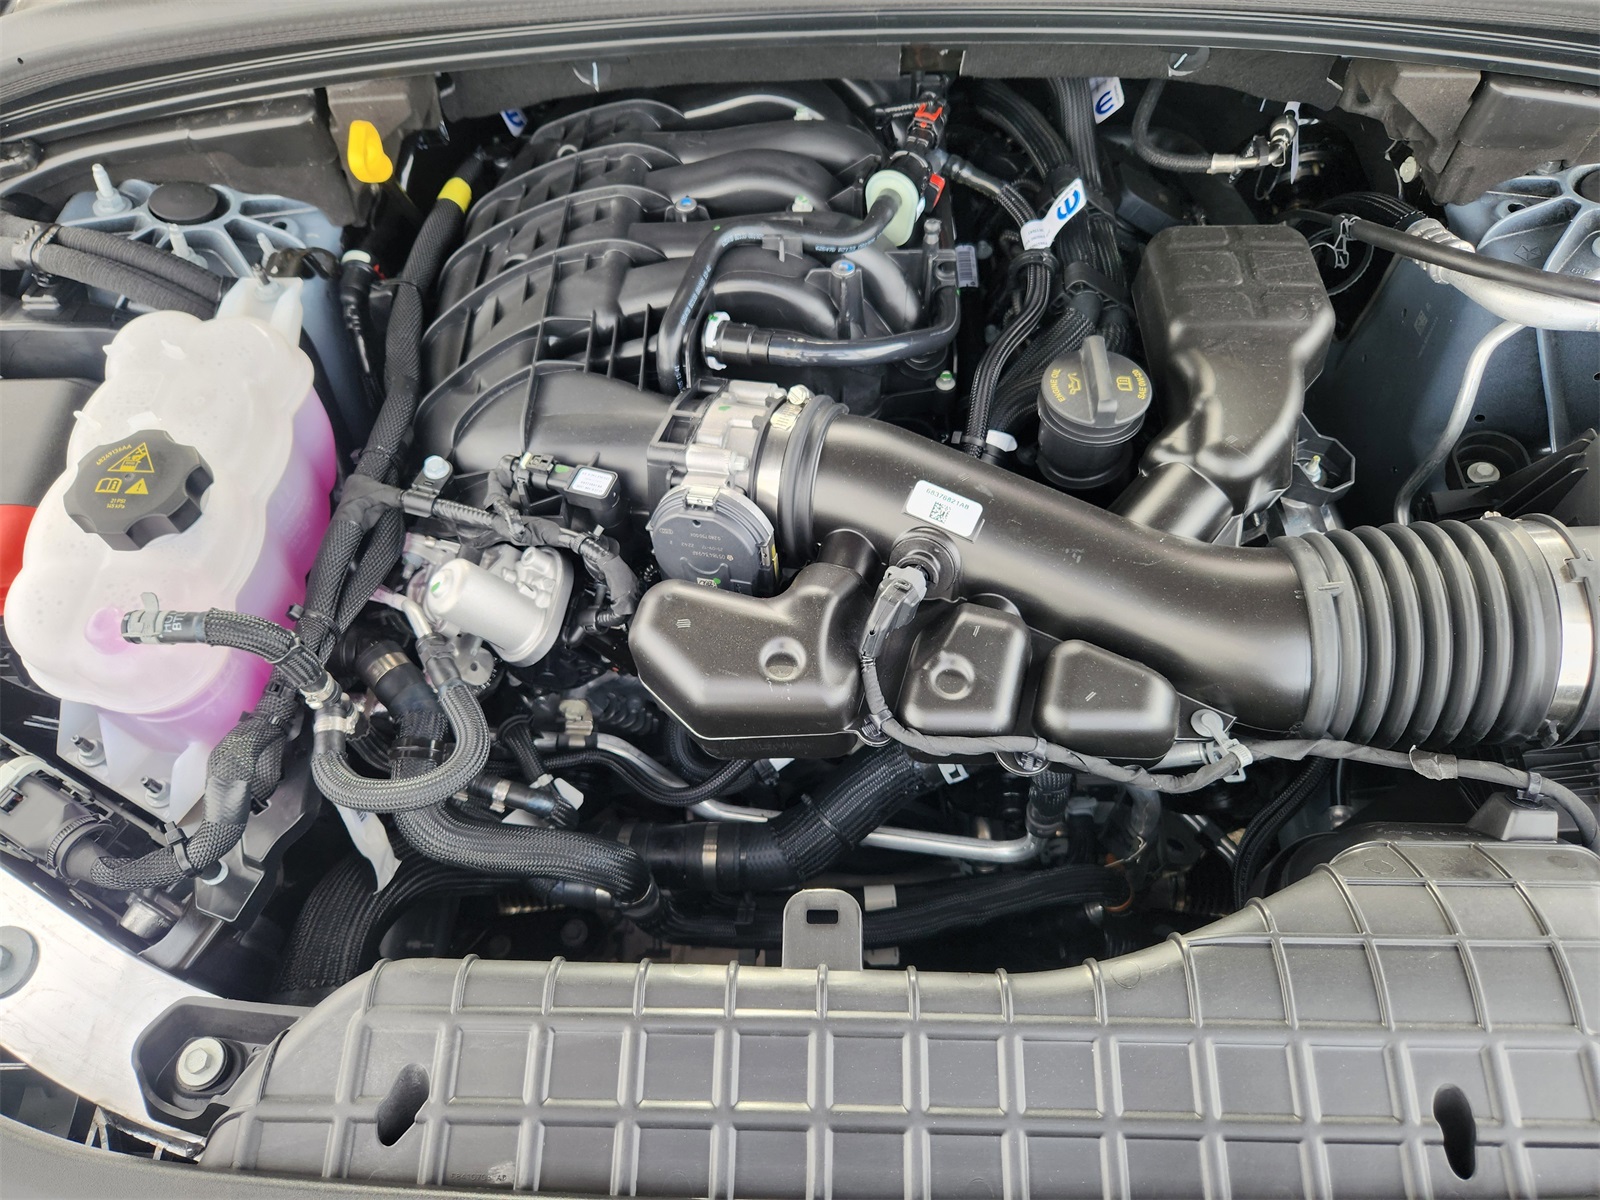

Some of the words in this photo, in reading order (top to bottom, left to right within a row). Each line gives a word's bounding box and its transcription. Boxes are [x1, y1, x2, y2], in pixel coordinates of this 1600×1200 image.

[1051, 369, 1061, 379] OIL
[1050, 379, 1066, 402] ENGINE
[1137, 387, 1147, 400] SAE
